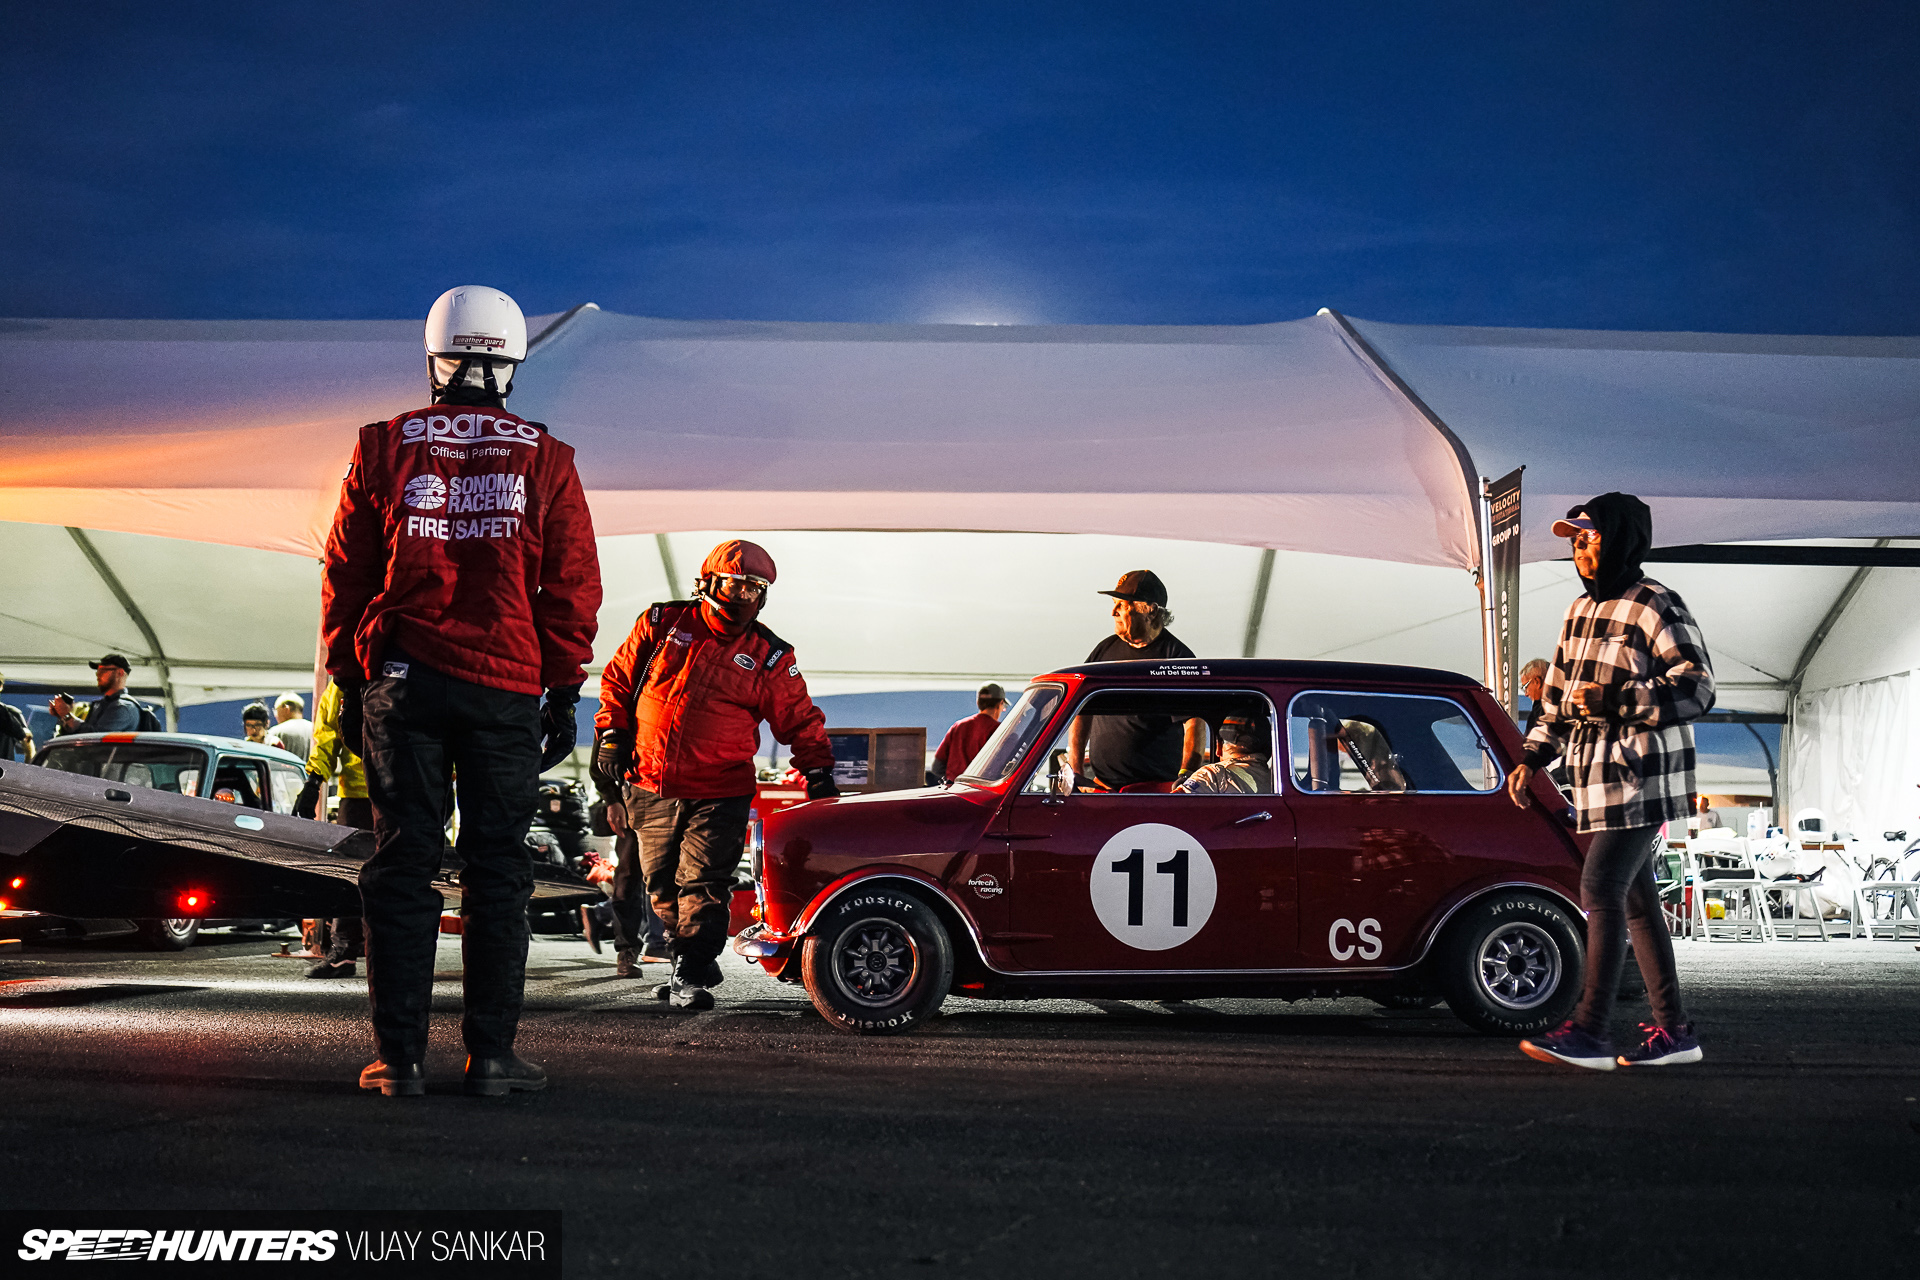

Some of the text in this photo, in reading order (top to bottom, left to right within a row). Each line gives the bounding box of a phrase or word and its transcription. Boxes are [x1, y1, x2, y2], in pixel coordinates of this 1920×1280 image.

[402, 413, 540, 443] sparco
[430, 446, 512, 459] Official Partner
[449, 473, 526, 496] SONOMA
[447, 492, 528, 515] RACEWAY
[1490, 490, 1521, 515] VELOCITY
[407, 515, 521, 541] FIRE/SAFETY
[1492, 523, 1519, 547] GROUP 10
[1348, 740, 1363, 760] Safety
[980, 887, 1003, 895] racing
[1111, 848, 1190, 928] 11
[1328, 917, 1383, 961] CS
